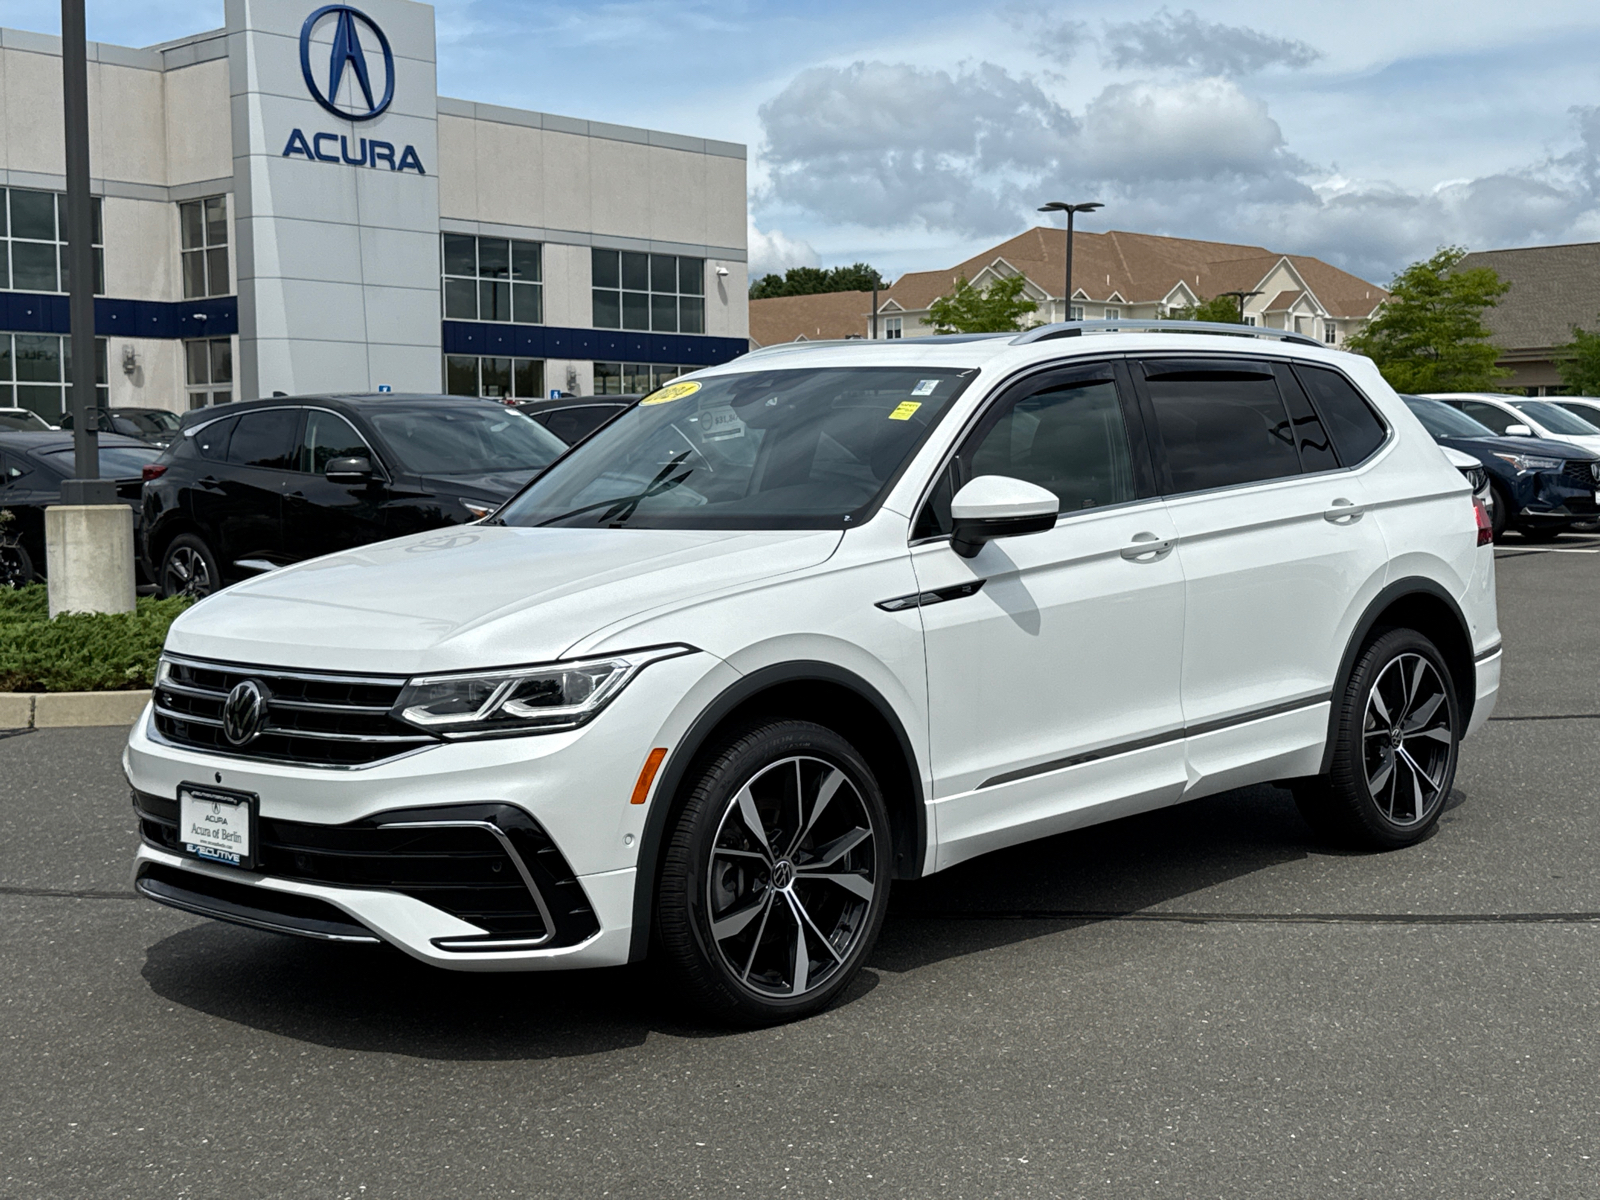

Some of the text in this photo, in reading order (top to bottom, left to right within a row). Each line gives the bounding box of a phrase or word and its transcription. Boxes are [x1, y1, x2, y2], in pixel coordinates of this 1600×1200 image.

[282, 128, 426, 174] ACURA
[205, 814, 228, 826] ACURA
[191, 822, 242, 843] Acura of Berlin
[186, 843, 240, 862] EXECUTIVE
